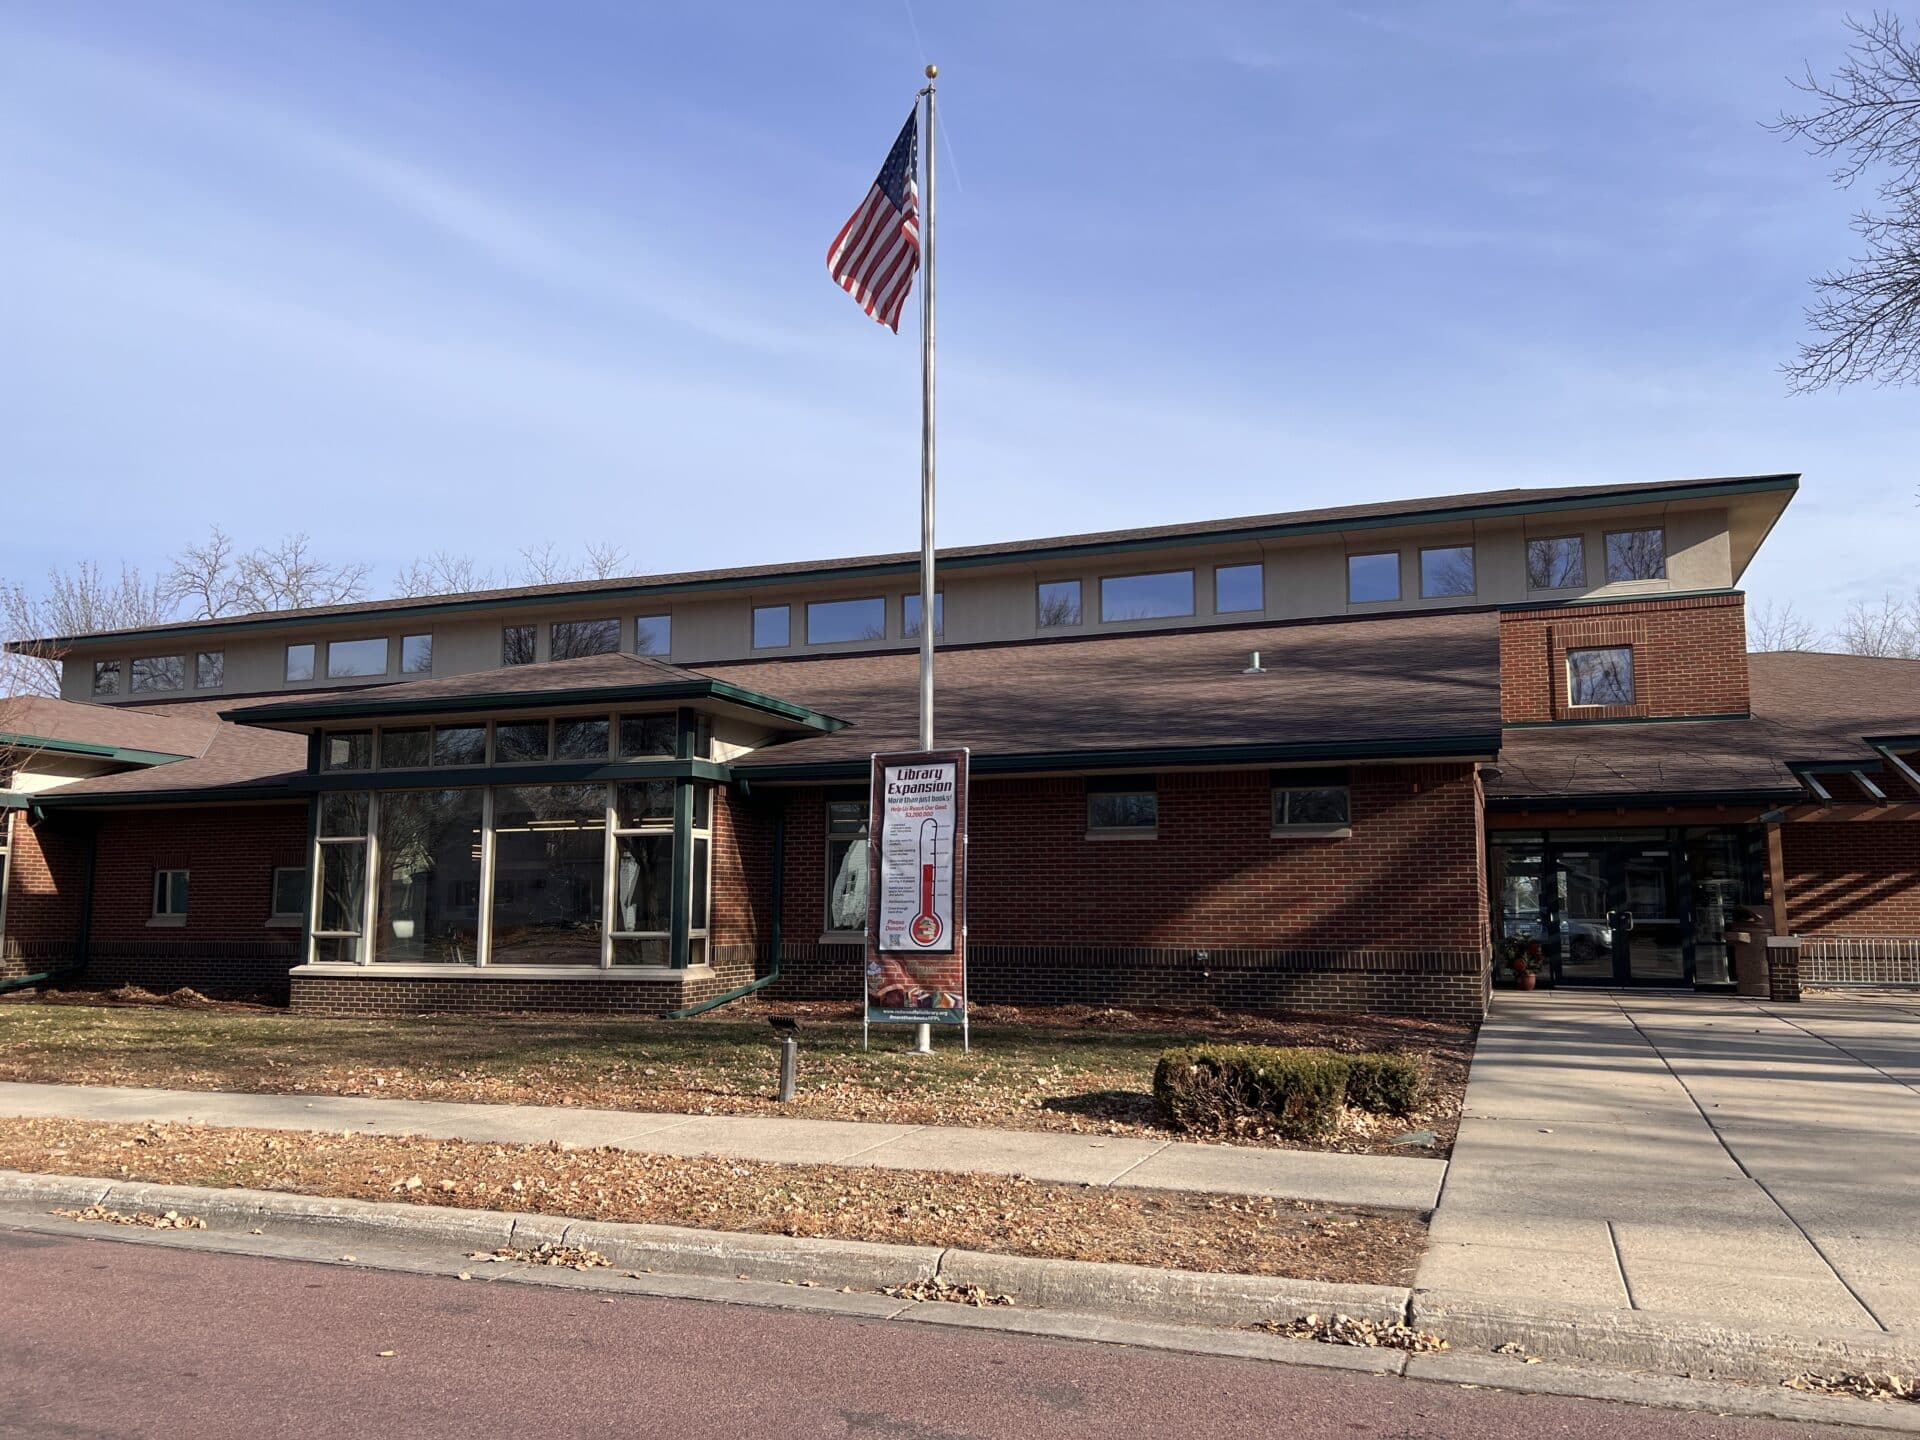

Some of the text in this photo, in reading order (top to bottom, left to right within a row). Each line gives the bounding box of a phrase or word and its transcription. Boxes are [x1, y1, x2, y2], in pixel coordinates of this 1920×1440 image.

[897, 768, 943, 780] Library
[888, 781, 952, 795] Expansion
[919, 796, 931, 804] just
